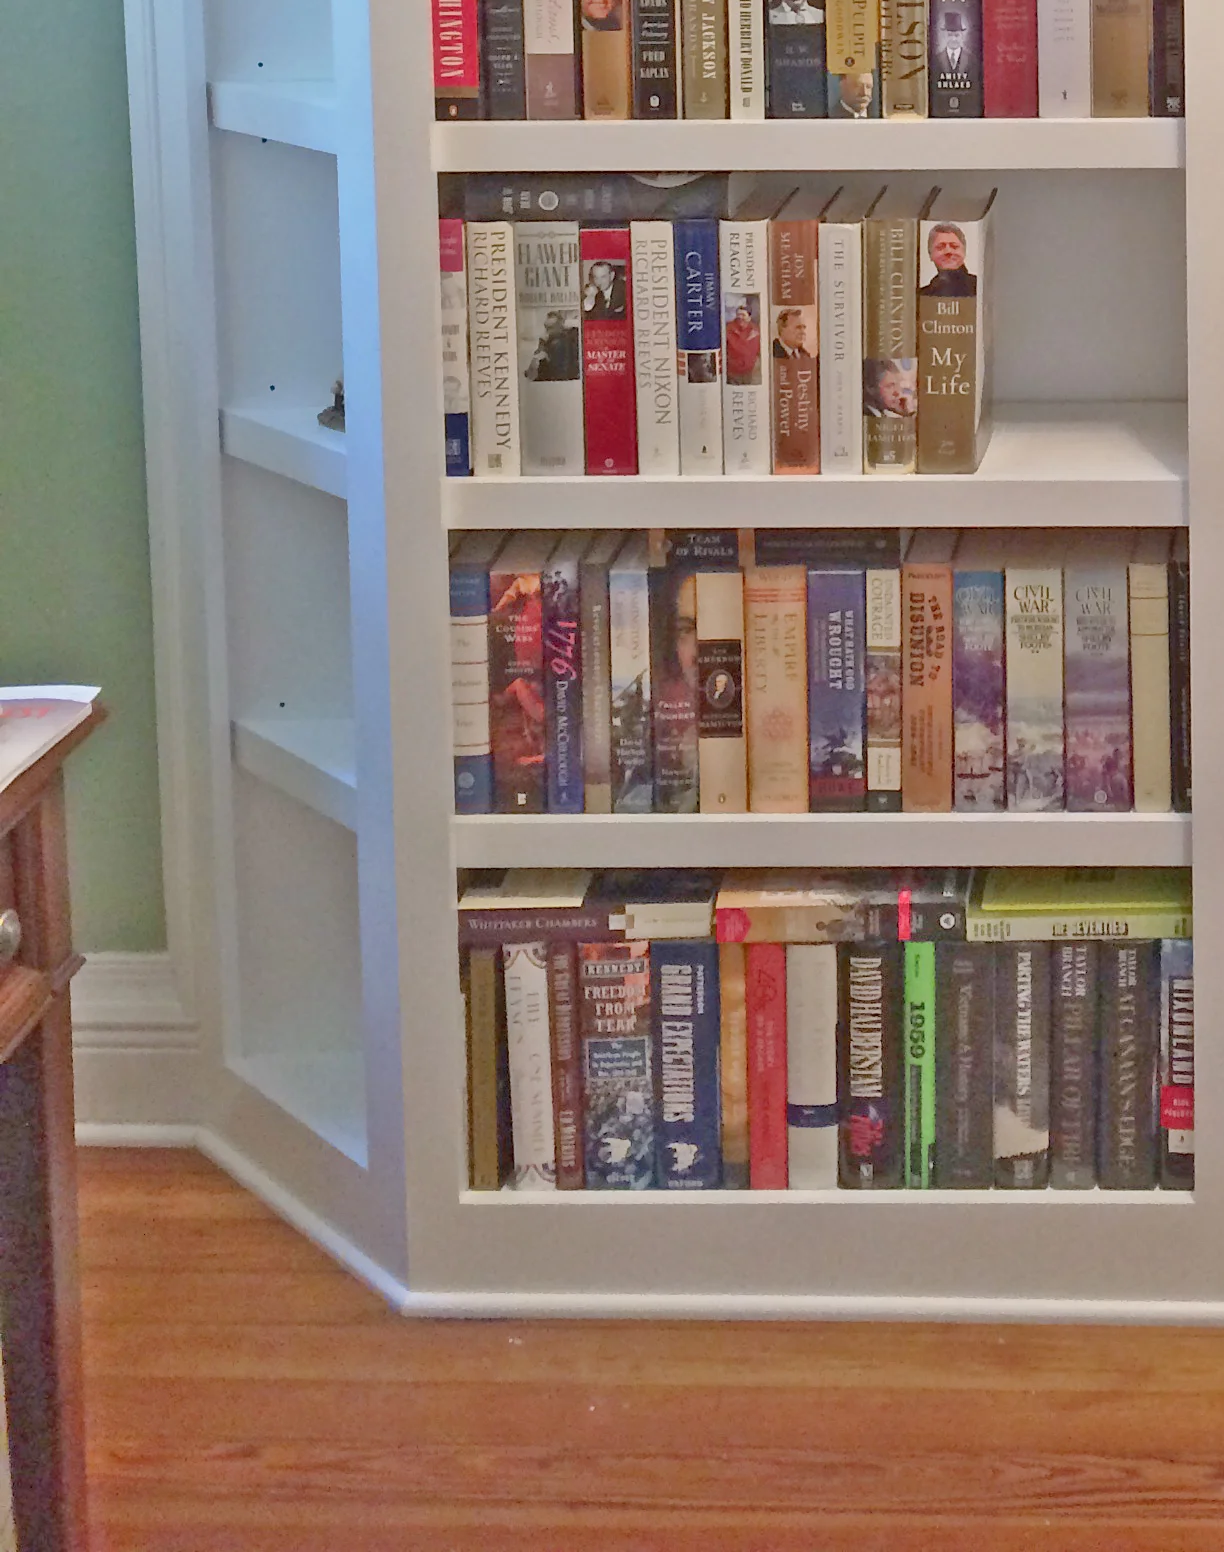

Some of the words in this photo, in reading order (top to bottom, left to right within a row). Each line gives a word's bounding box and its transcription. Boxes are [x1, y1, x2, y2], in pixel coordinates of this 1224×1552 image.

[701, 10, 716, 79] JACKSON
[491, 231, 508, 344] PRESIDENT
[729, 232, 740, 288] REAGAN
[650, 240, 668, 351] PRESIDENT
[685, 252, 703, 334] CARTER
[938, 302, 959, 315] Bill
[922, 320, 973, 334] Clinton
[926, 376, 970, 395] Life
[931, 348, 966, 367] My
[492, 352, 511, 449] KENNEDY
[654, 358, 672, 426] NIXON
[780, 388, 792, 437] Power
[798, 369, 809, 432] Destiny
[1013, 585, 1053, 601] CIVIL
[1018, 602, 1050, 613] WAR
[546, 621, 578, 680] 1776
[829, 610, 842, 690] WROUGHT
[909, 592, 925, 687] DISUNION
[595, 1003, 635, 1016] FROM
[661, 964, 692, 1015] GRAND
[909, 1002, 926, 1059] 1959
[662, 1021, 694, 1122] EXPECTATIONS
